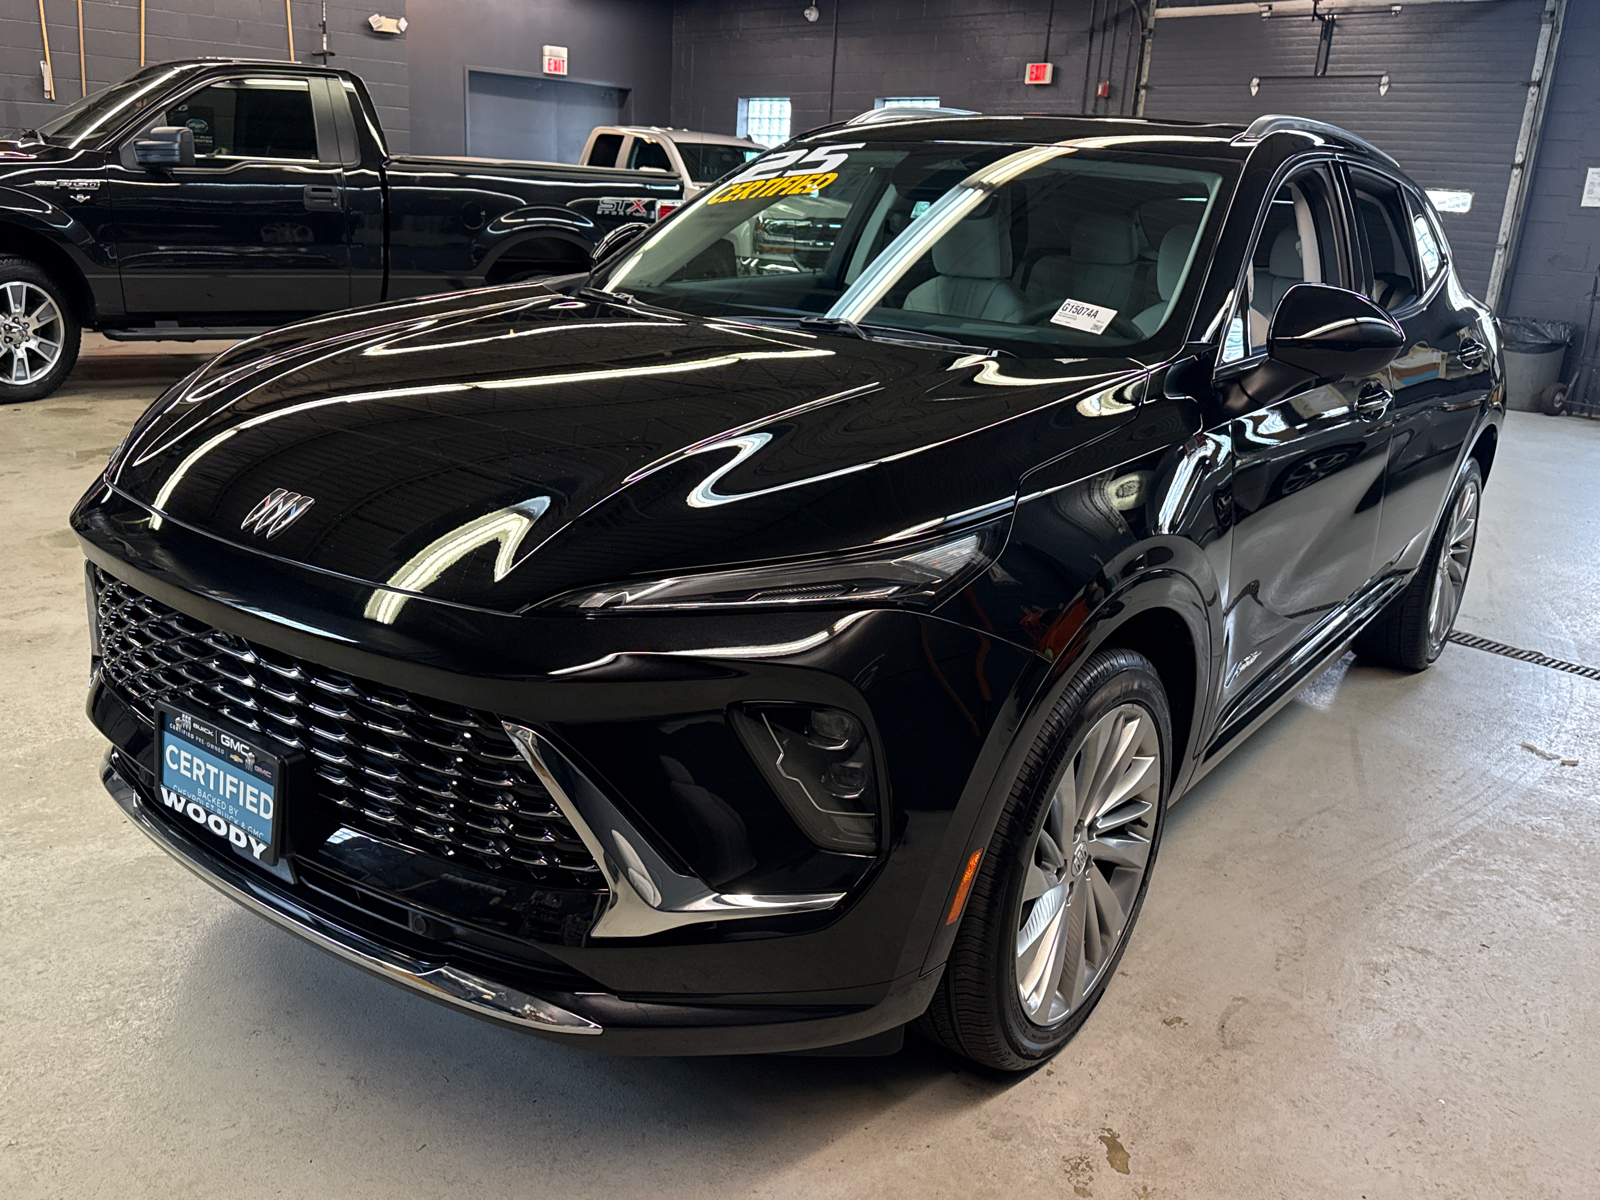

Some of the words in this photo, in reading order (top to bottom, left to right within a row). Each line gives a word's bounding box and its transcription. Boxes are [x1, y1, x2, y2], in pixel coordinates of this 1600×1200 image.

[547, 57, 566, 74] EXIT
[1028, 63, 1048, 82] EXIT
[732, 142, 867, 184] 25
[707, 172, 839, 205] CERTIFIED
[597, 197, 649, 212] STX
[1061, 302, 1099, 320] G15074A
[193, 722, 214, 737] BUICK
[220, 733, 250, 757] GMC
[165, 744, 274, 820] CERTIFIED
[197, 787, 227, 810] BACKED
[228, 804, 239, 816] BY
[160, 785, 268, 860] WOODY
